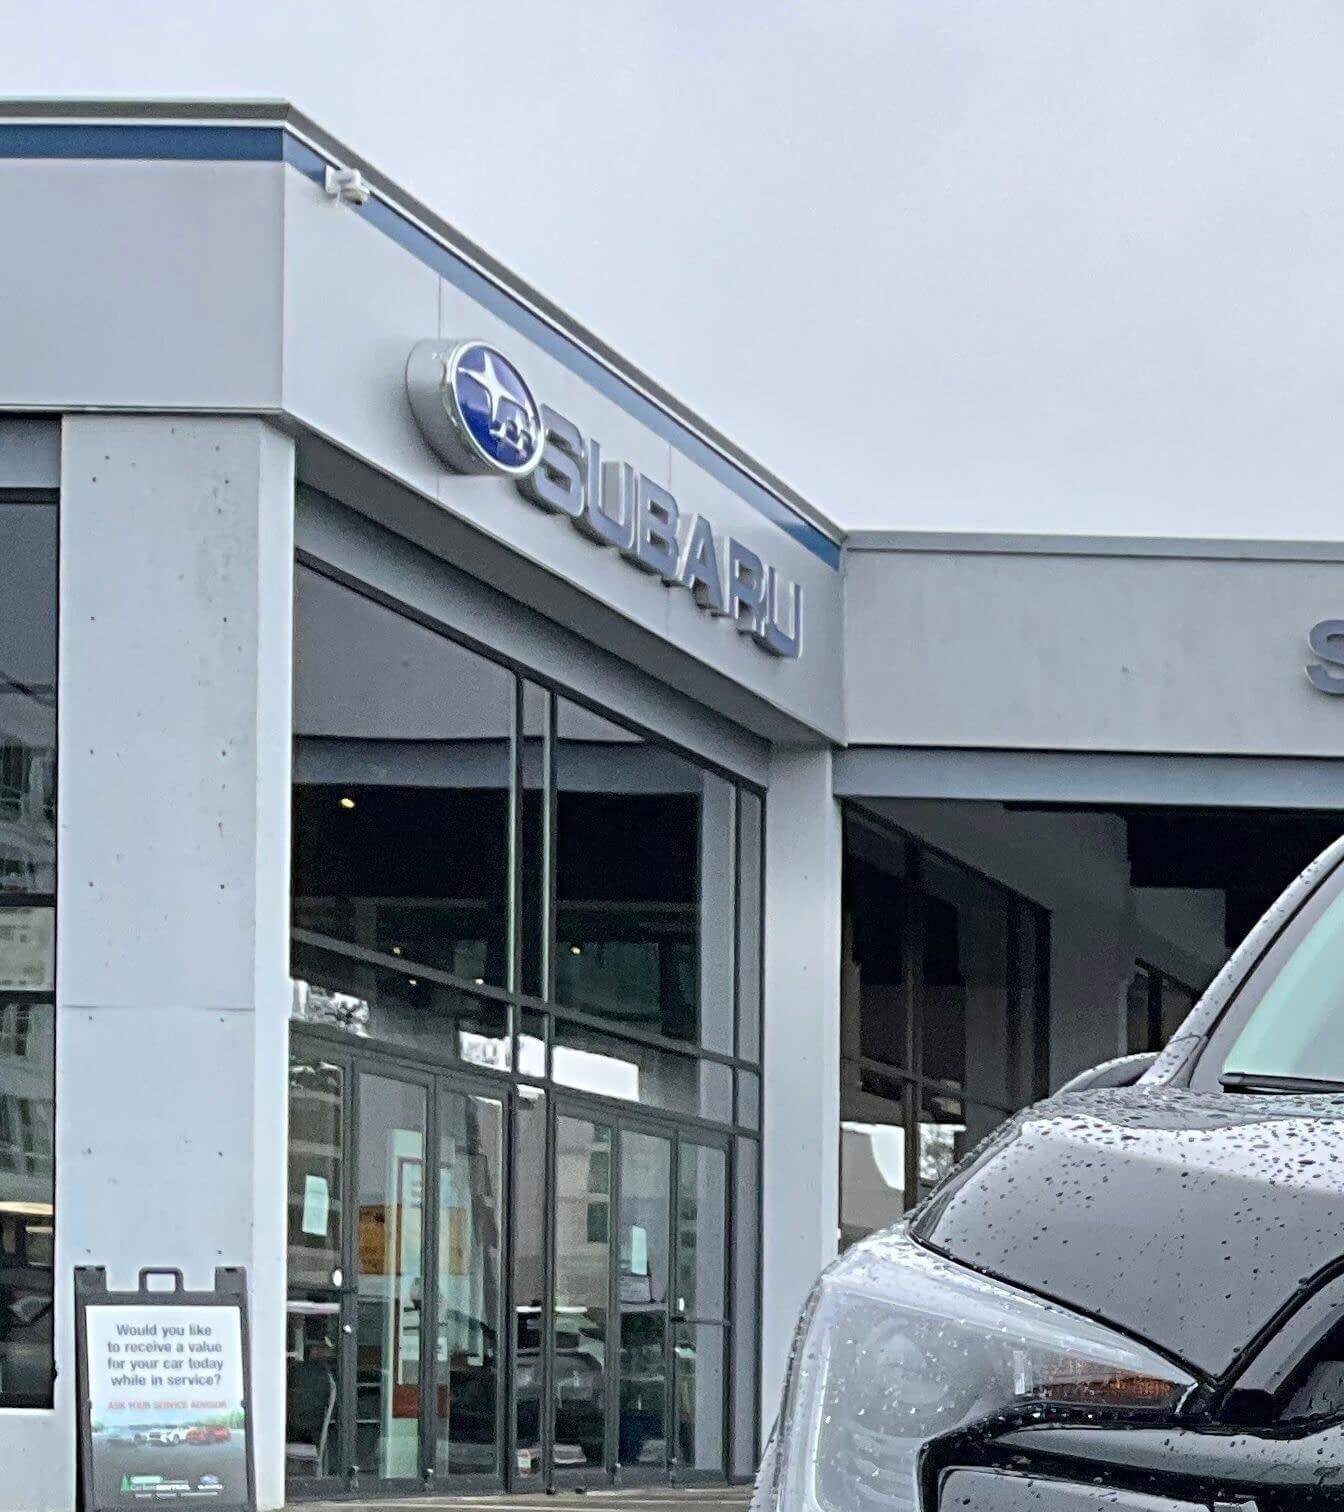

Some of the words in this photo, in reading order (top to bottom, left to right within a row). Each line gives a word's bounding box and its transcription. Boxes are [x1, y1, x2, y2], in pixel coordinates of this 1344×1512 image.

[520, 403, 803, 658] SUBARU
[117, 1324, 157, 1336] Would
[162, 1327, 185, 1339] you
[189, 1324, 212, 1336] like
[107, 1341, 120, 1353] to
[125, 1341, 171, 1353] receive
[176, 1344, 184, 1353] a
[188, 1341, 222, 1353] value
[107, 1357, 125, 1369] for
[130, 1360, 158, 1371] your
[163, 1360, 184, 1369] car
[188, 1357, 224, 1371] today
[111, 1374, 146, 1386] while
[151, 1374, 162, 1386] in
[167, 1374, 222, 1386] service?
